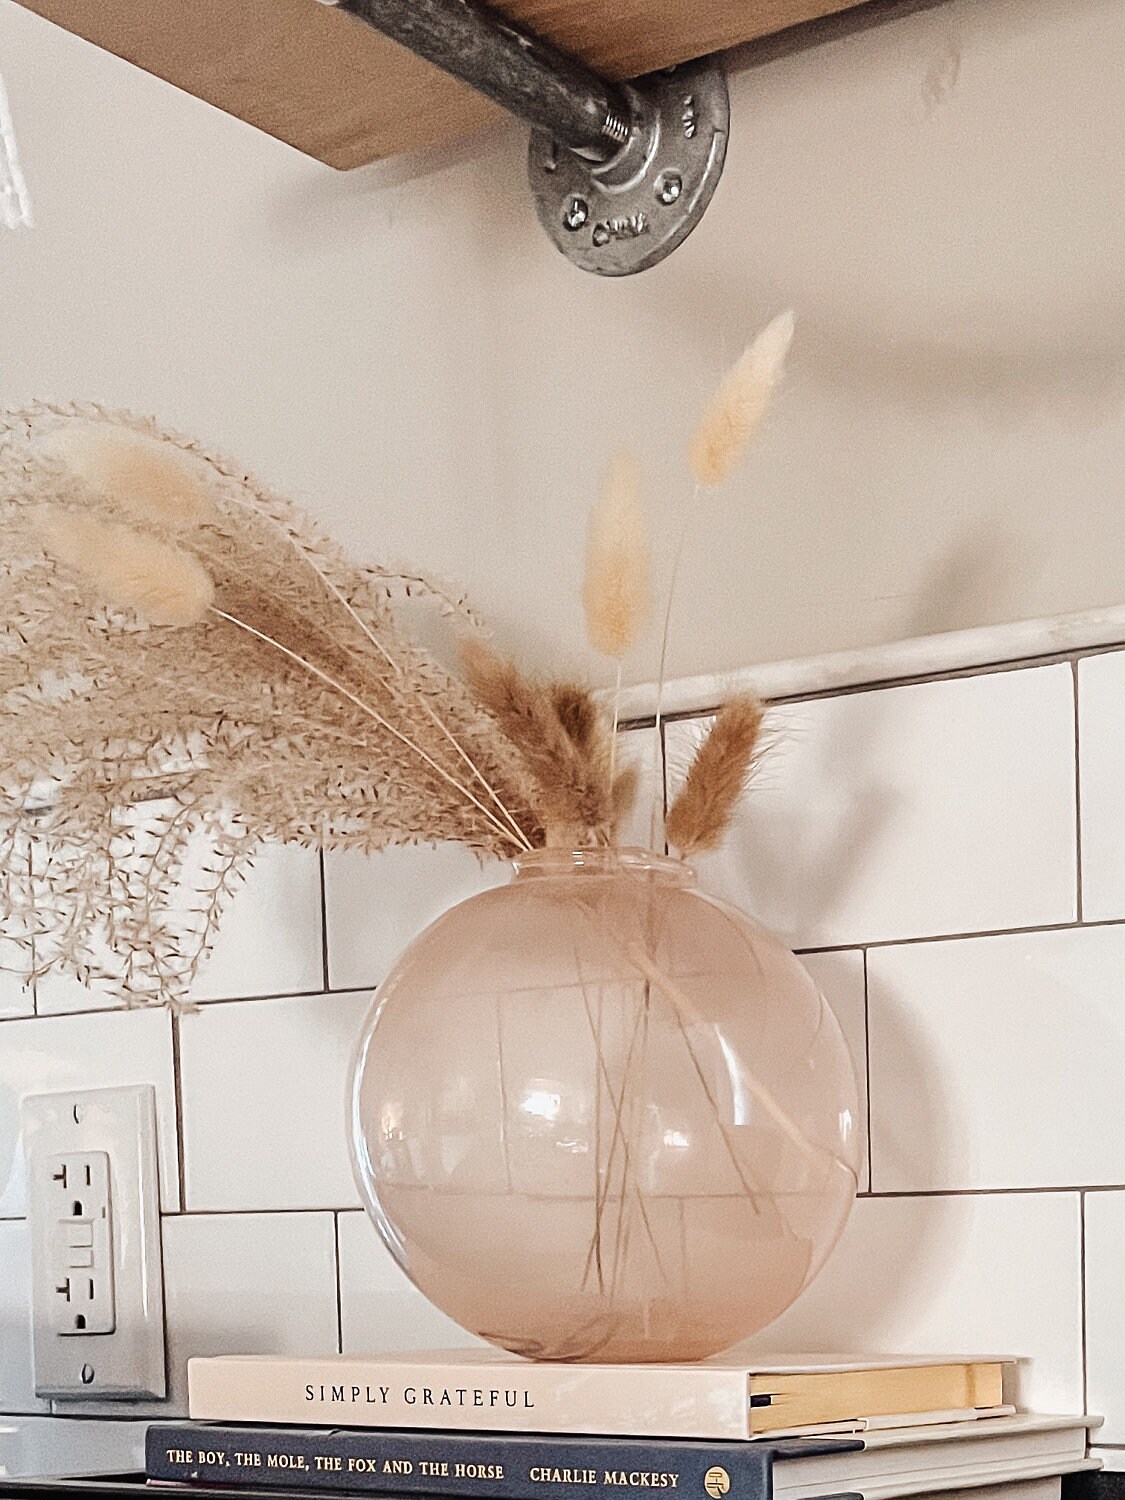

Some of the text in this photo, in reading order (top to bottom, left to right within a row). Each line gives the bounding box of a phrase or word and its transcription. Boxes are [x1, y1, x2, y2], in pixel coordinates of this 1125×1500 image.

[305, 1385, 535, 1408] SIMPLY GRATEFUL
[166, 1450, 505, 1480] THE BOY, THE MOLE, THE FOX AND THE HORSE
[529, 1467, 679, 1488] CHARLIE MACKESY
